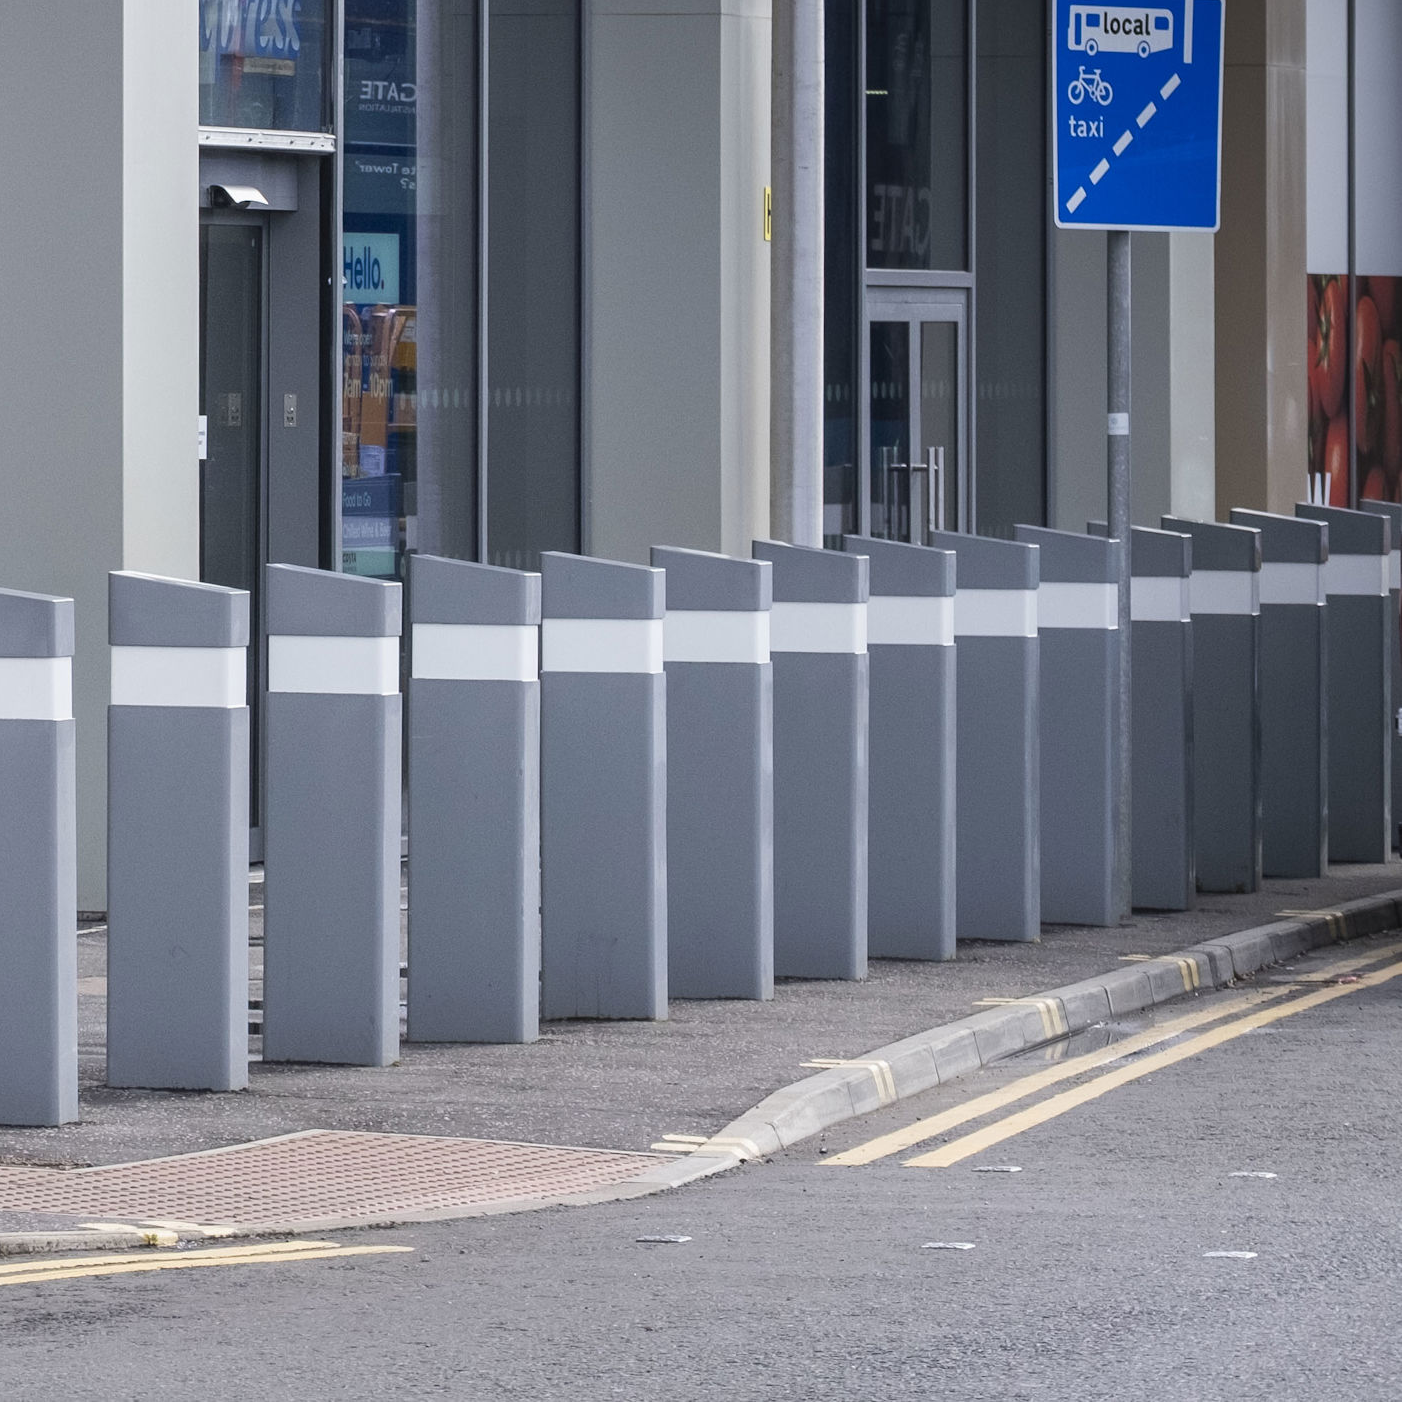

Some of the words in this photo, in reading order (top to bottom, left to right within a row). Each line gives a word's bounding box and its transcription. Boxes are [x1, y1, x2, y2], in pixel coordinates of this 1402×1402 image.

[1103, 11, 1151, 36] local
[1068, 115, 1105, 139] taxi
[370, 371, 394, 406] 10pm
